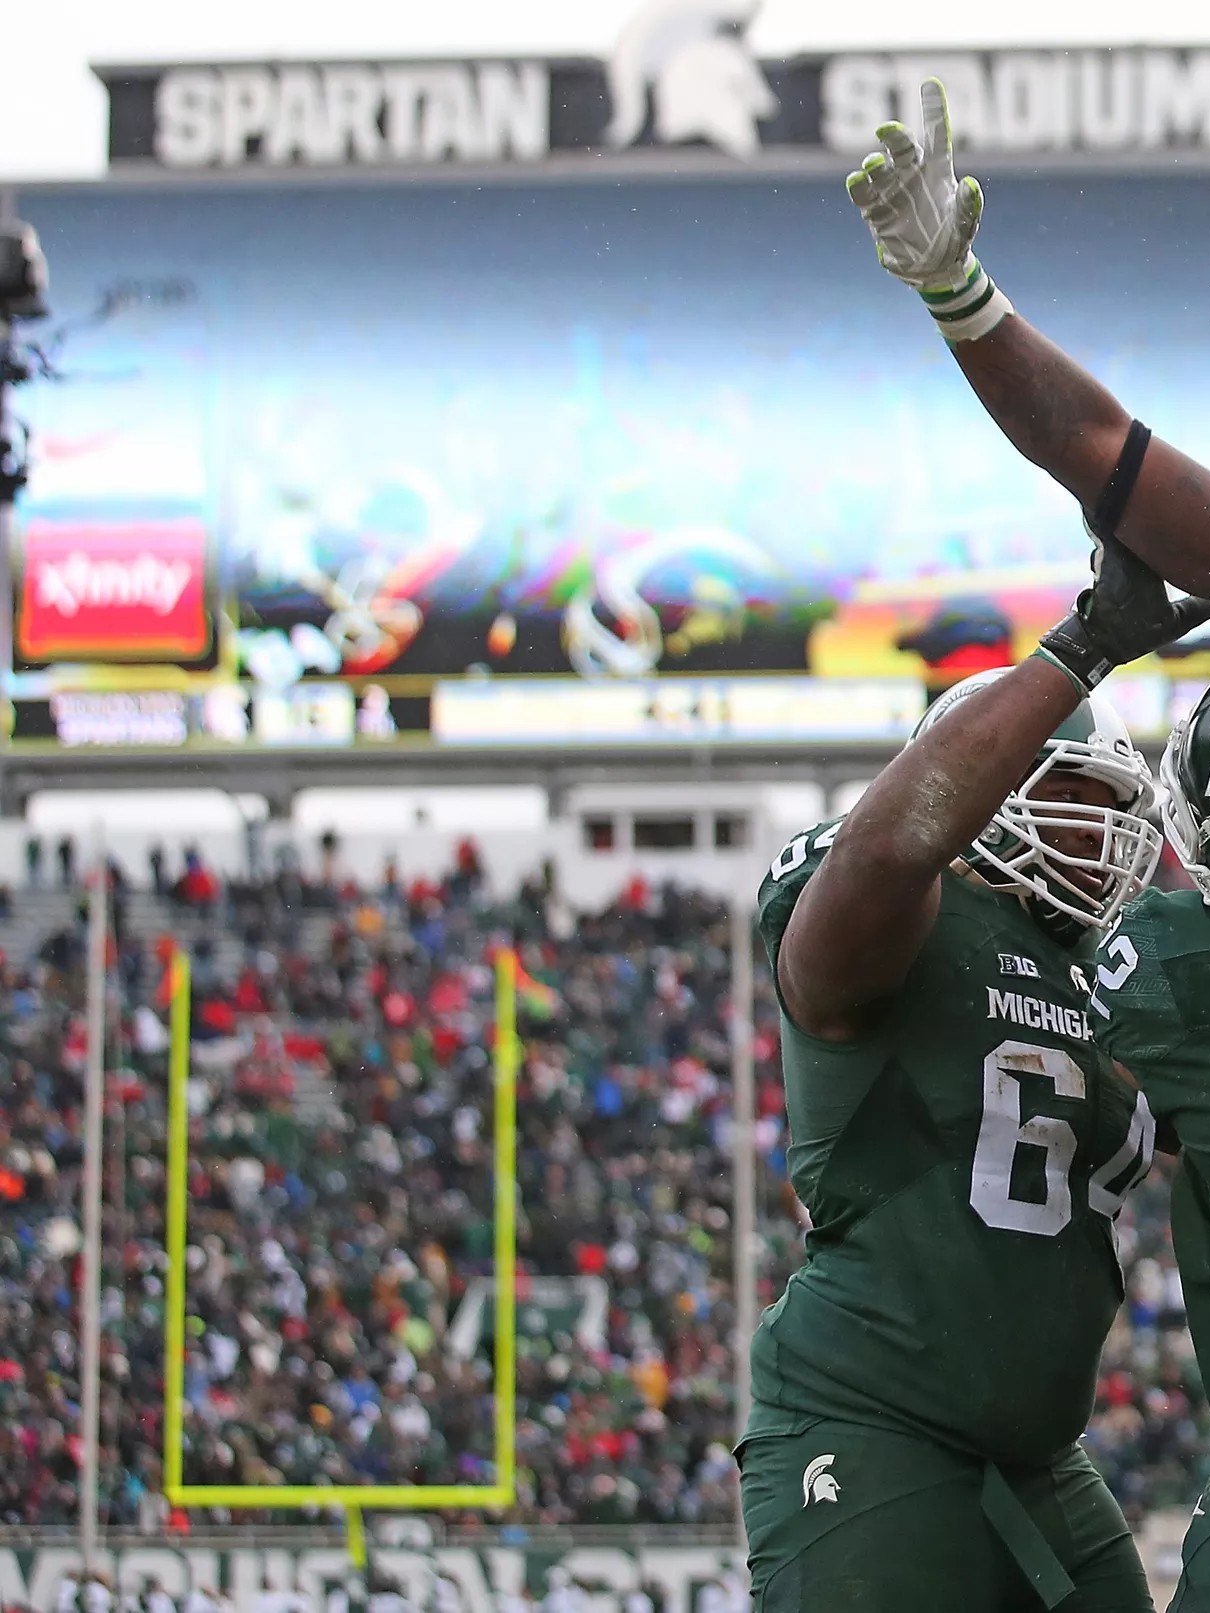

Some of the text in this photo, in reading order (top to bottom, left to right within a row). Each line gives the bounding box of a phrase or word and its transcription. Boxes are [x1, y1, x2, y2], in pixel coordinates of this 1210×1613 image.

[155, 64, 550, 166] SPARTAN
[36, 552, 192, 618] xfinity
[969, 1039, 1157, 1237] 64
